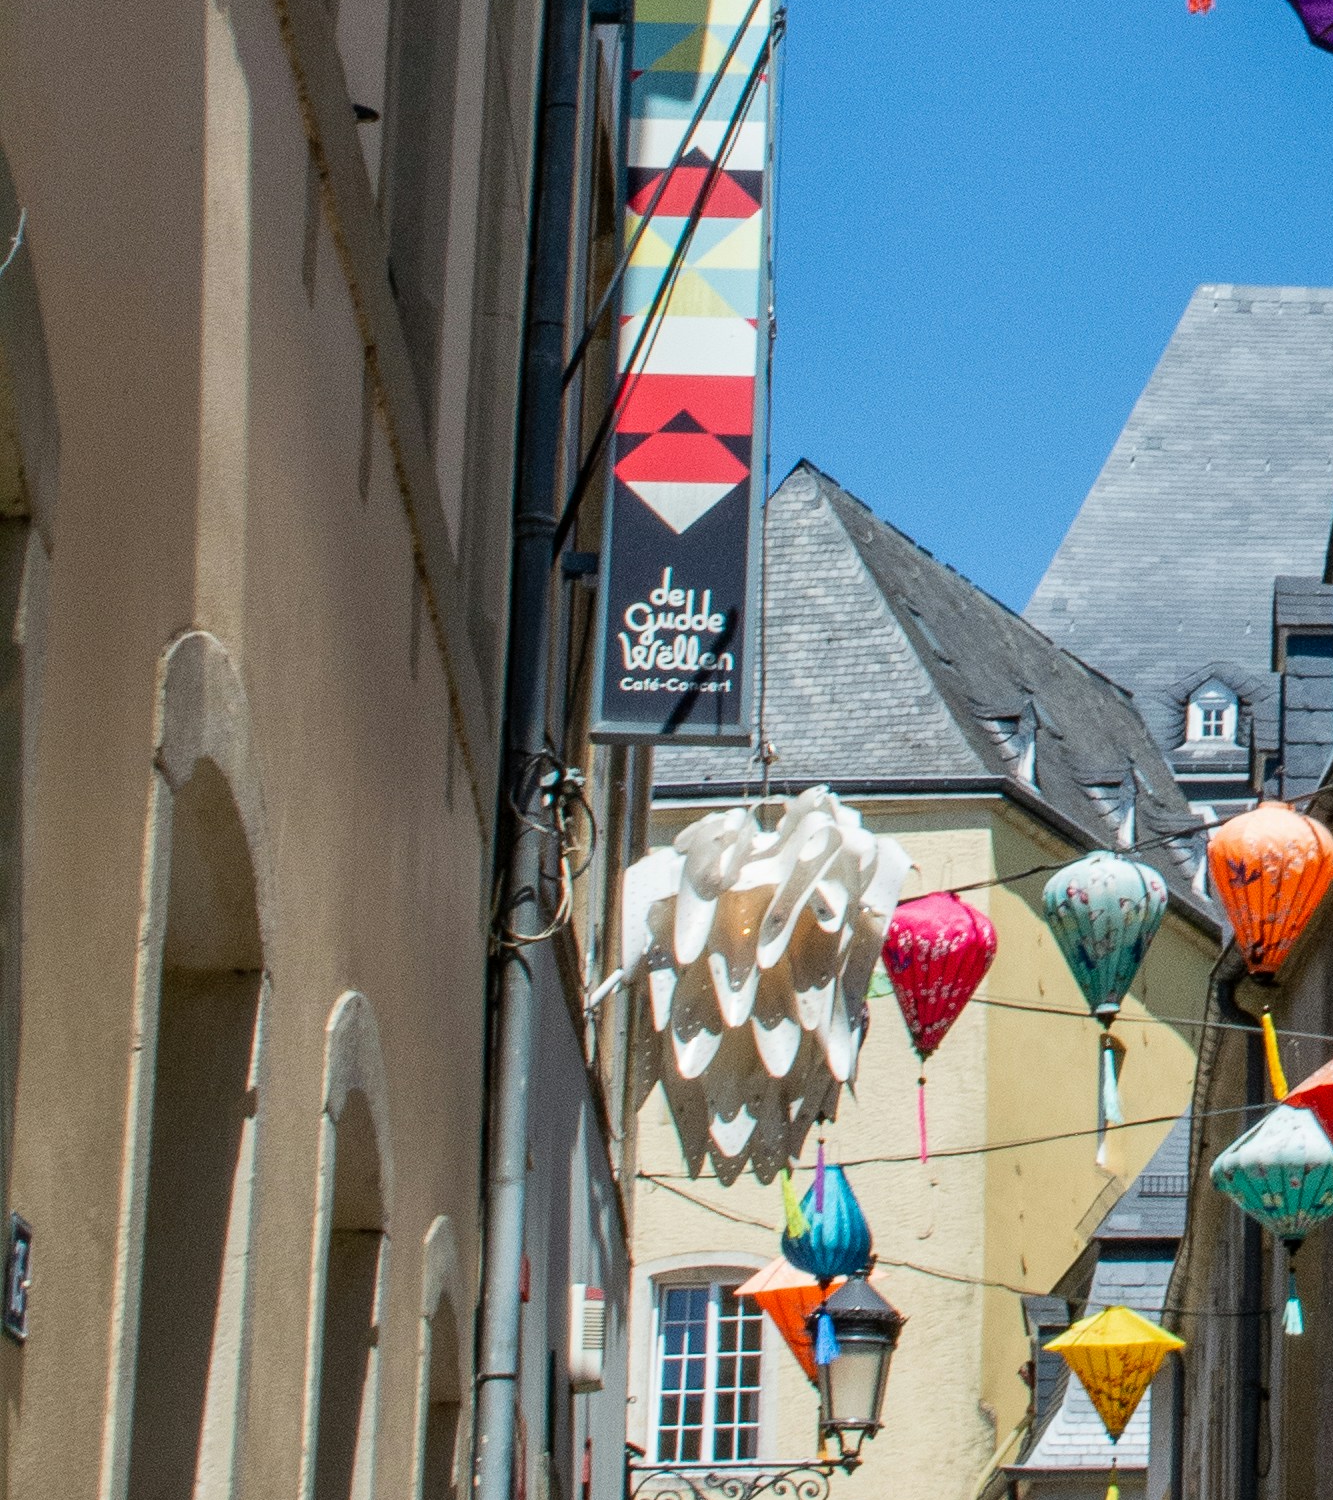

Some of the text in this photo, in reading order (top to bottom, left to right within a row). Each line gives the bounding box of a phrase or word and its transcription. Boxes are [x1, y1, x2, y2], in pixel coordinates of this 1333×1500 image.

[650, 565, 686, 607] de
[624, 589, 726, 646] Gudde
[618, 631, 735, 672] Wëllen
